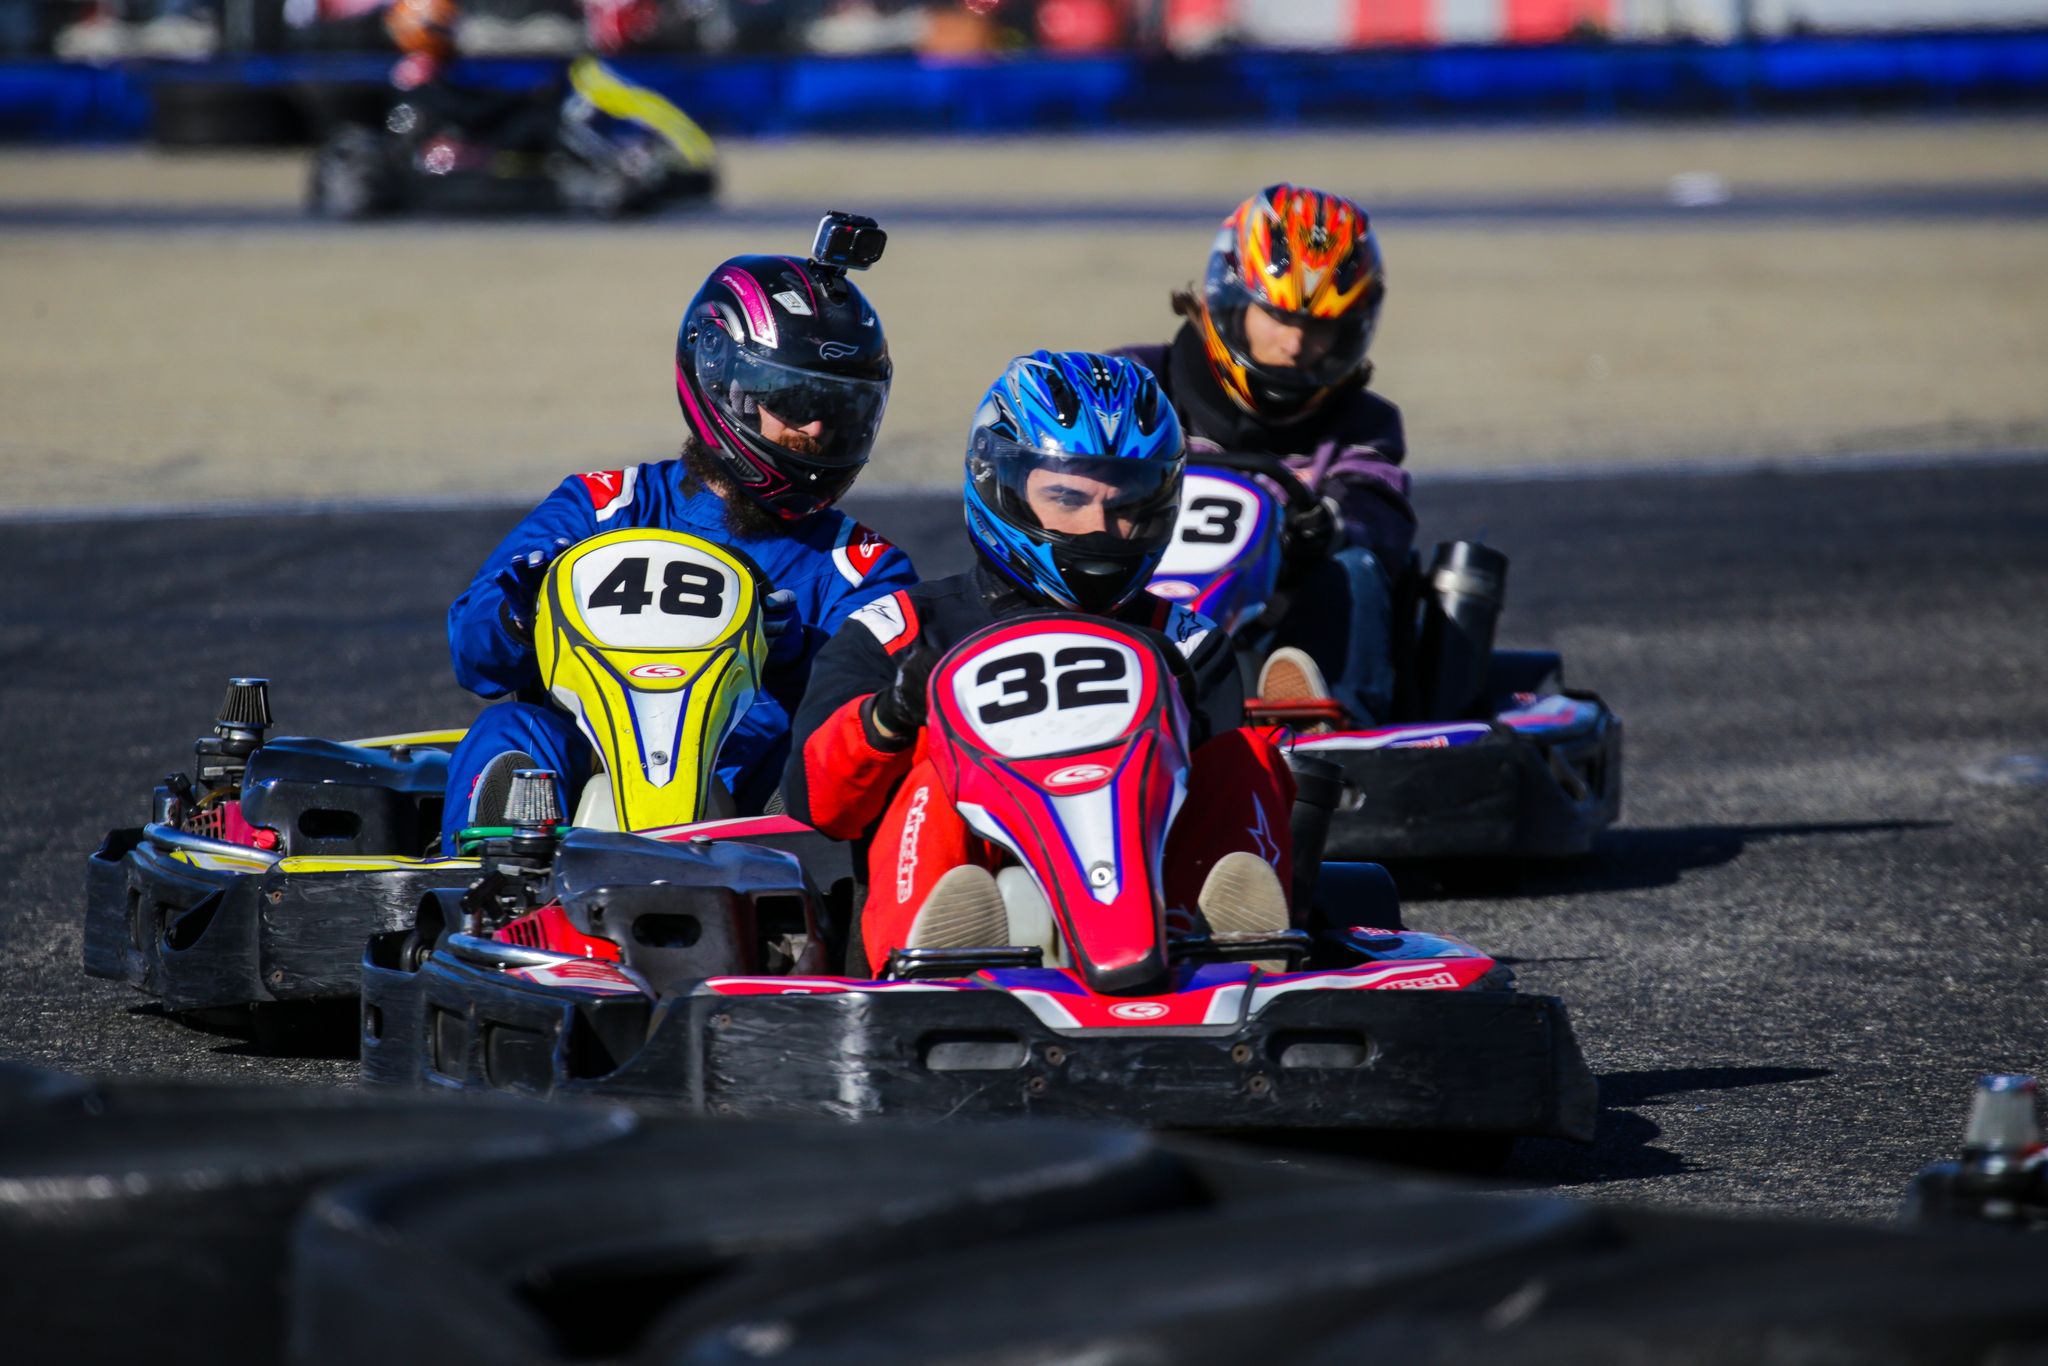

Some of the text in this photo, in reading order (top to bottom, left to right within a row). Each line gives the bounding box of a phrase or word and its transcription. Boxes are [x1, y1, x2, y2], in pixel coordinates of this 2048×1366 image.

[1182, 498, 1242, 543] 3
[587, 557, 725, 619] 48
[975, 646, 1130, 725] 32
